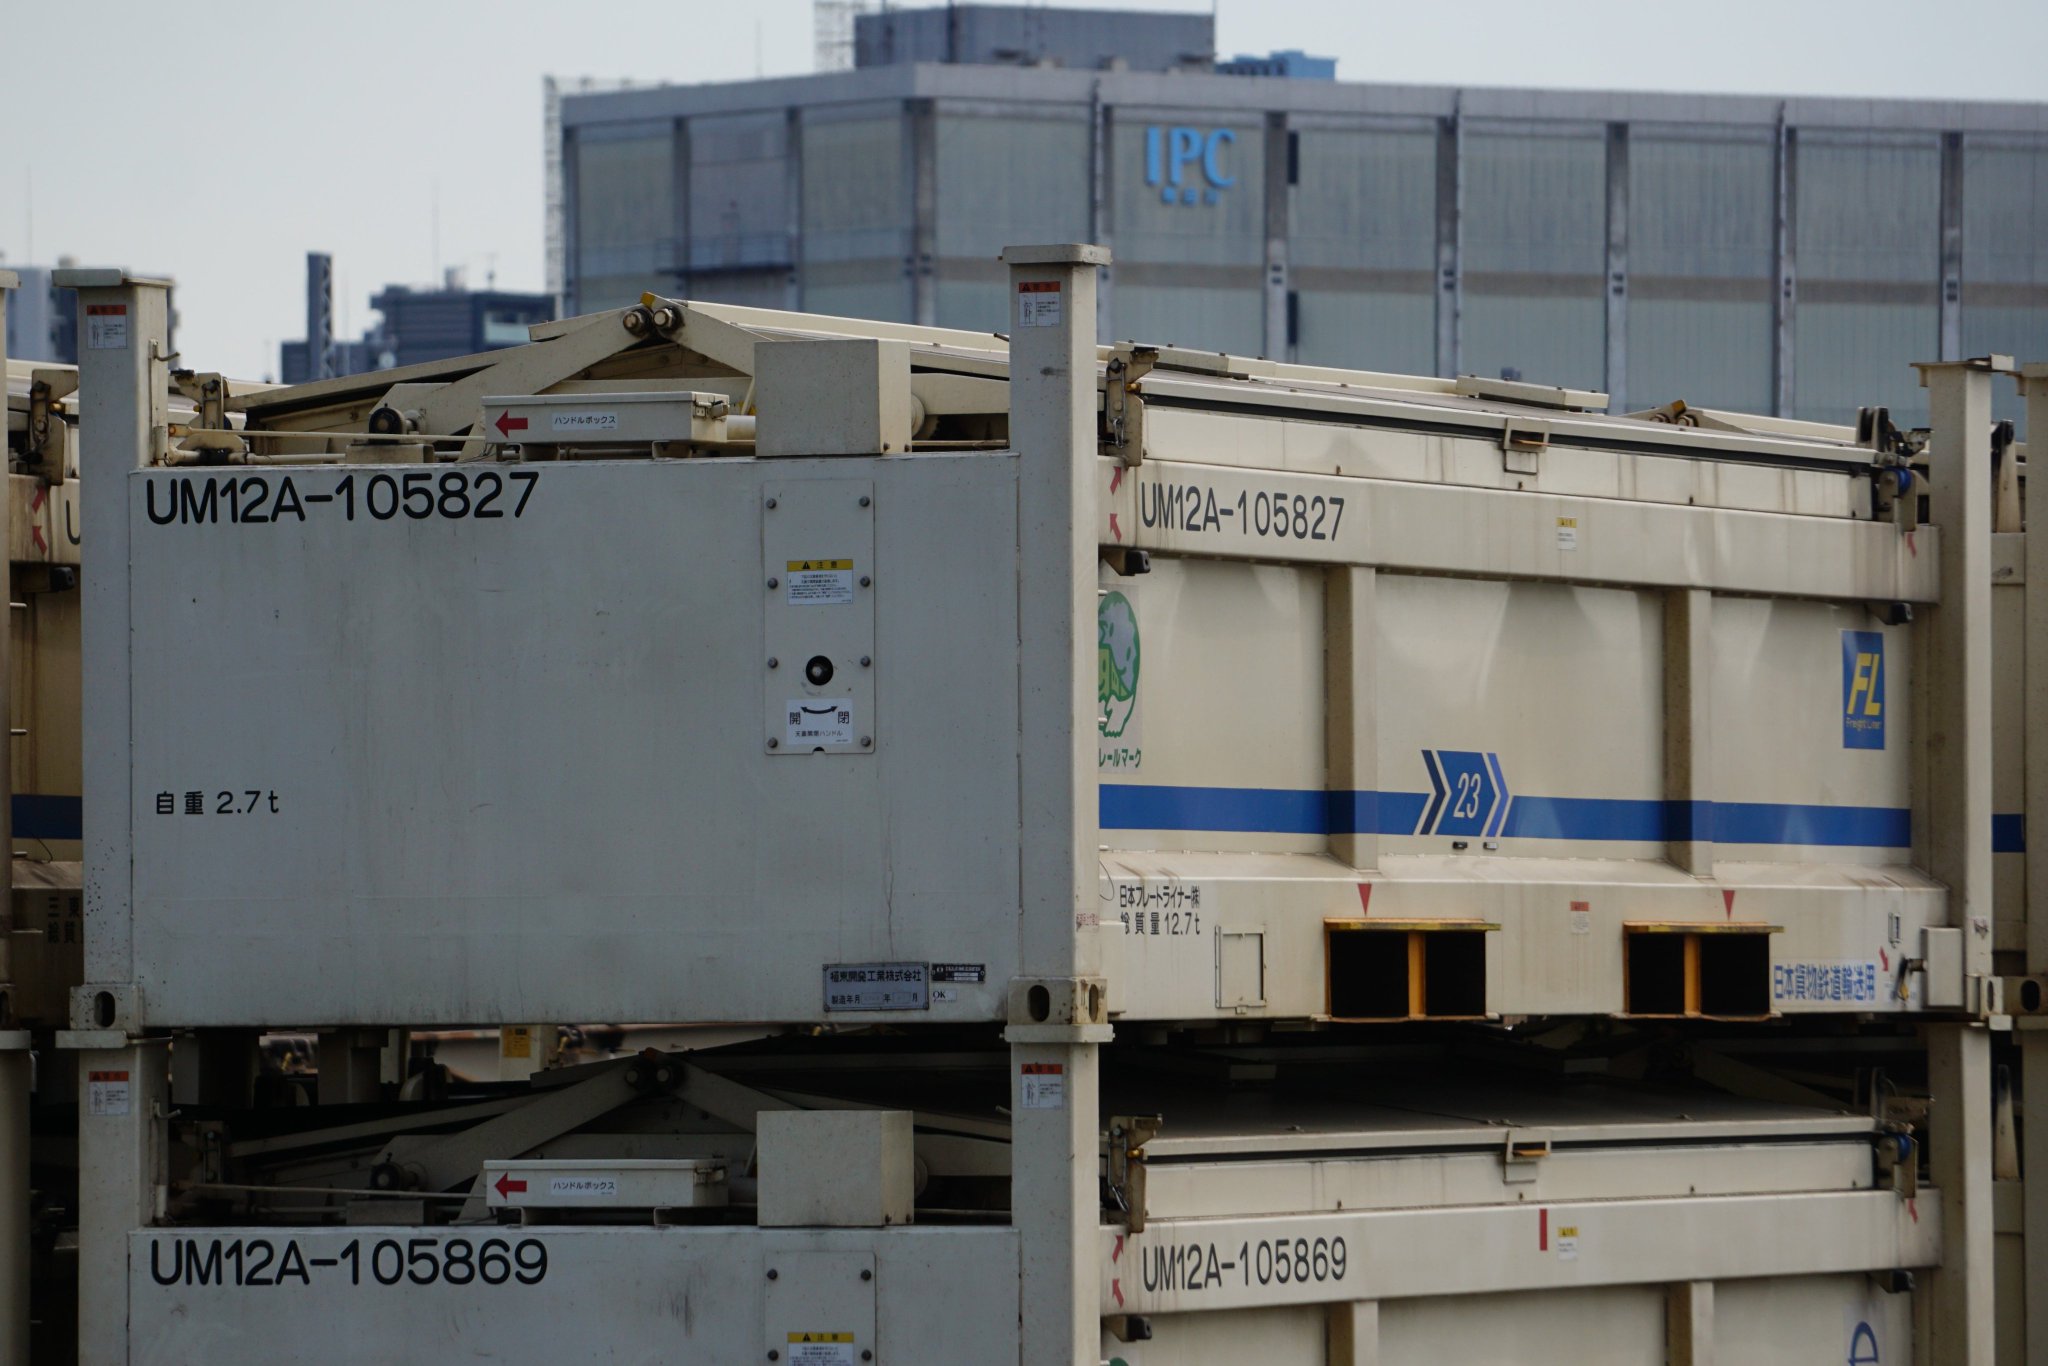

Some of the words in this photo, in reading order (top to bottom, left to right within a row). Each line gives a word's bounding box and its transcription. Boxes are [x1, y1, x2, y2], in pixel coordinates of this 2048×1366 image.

[1146, 126, 1236, 187] IPC
[554, 415, 616, 424] ハンドルボックス
[146, 471, 540, 525] UM12A-105827
[1141, 481, 1345, 542] UM12A-105827
[1846, 652, 1881, 715] FL
[789, 711, 801, 725] 開
[838, 711, 850, 724] 閉
[1453, 772, 1481, 818] 23
[830, 968, 921, 982] 極東開発工業株式会社
[553, 1181, 615, 1190] ハンドルボックス
[151, 1239, 548, 1285] UM12A-105869
[1143, 1236, 1347, 1292] UM12A-105869
